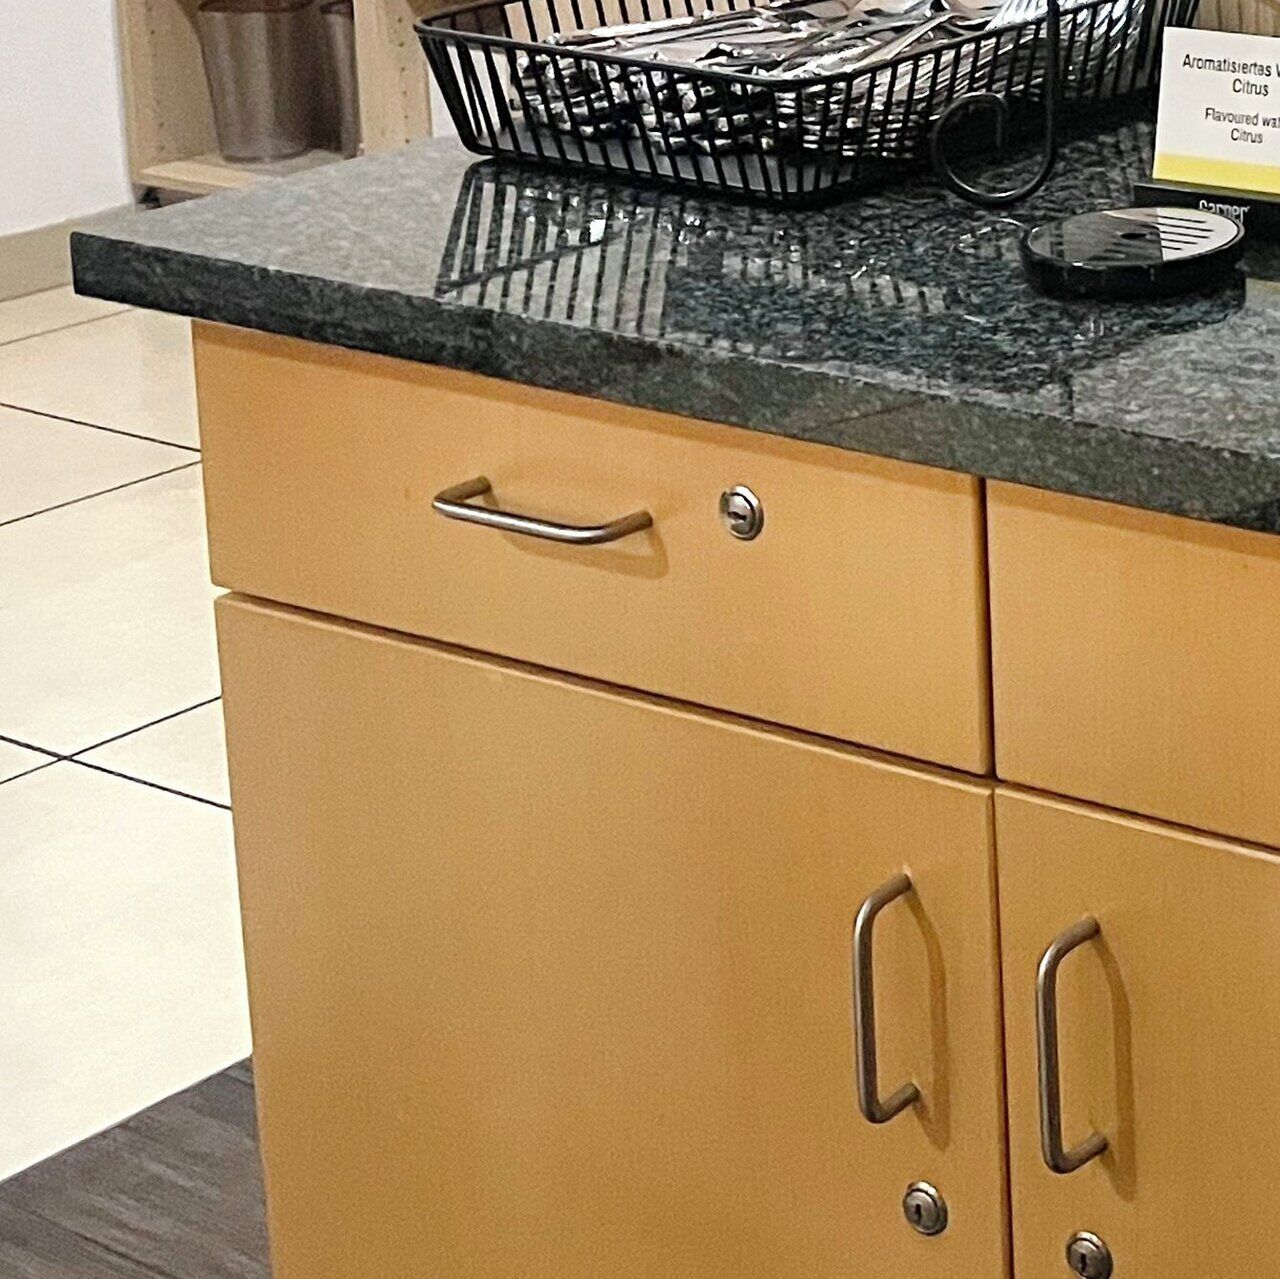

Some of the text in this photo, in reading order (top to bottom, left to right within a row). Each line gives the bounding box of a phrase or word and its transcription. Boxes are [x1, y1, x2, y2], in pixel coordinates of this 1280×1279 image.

[1182, 54, 1272, 78] Aromatisiertes
[1232, 78, 1269, 97] Citrus
[1205, 107, 1259, 126] Flavoured
[1230, 128, 1264, 144] Citrus
